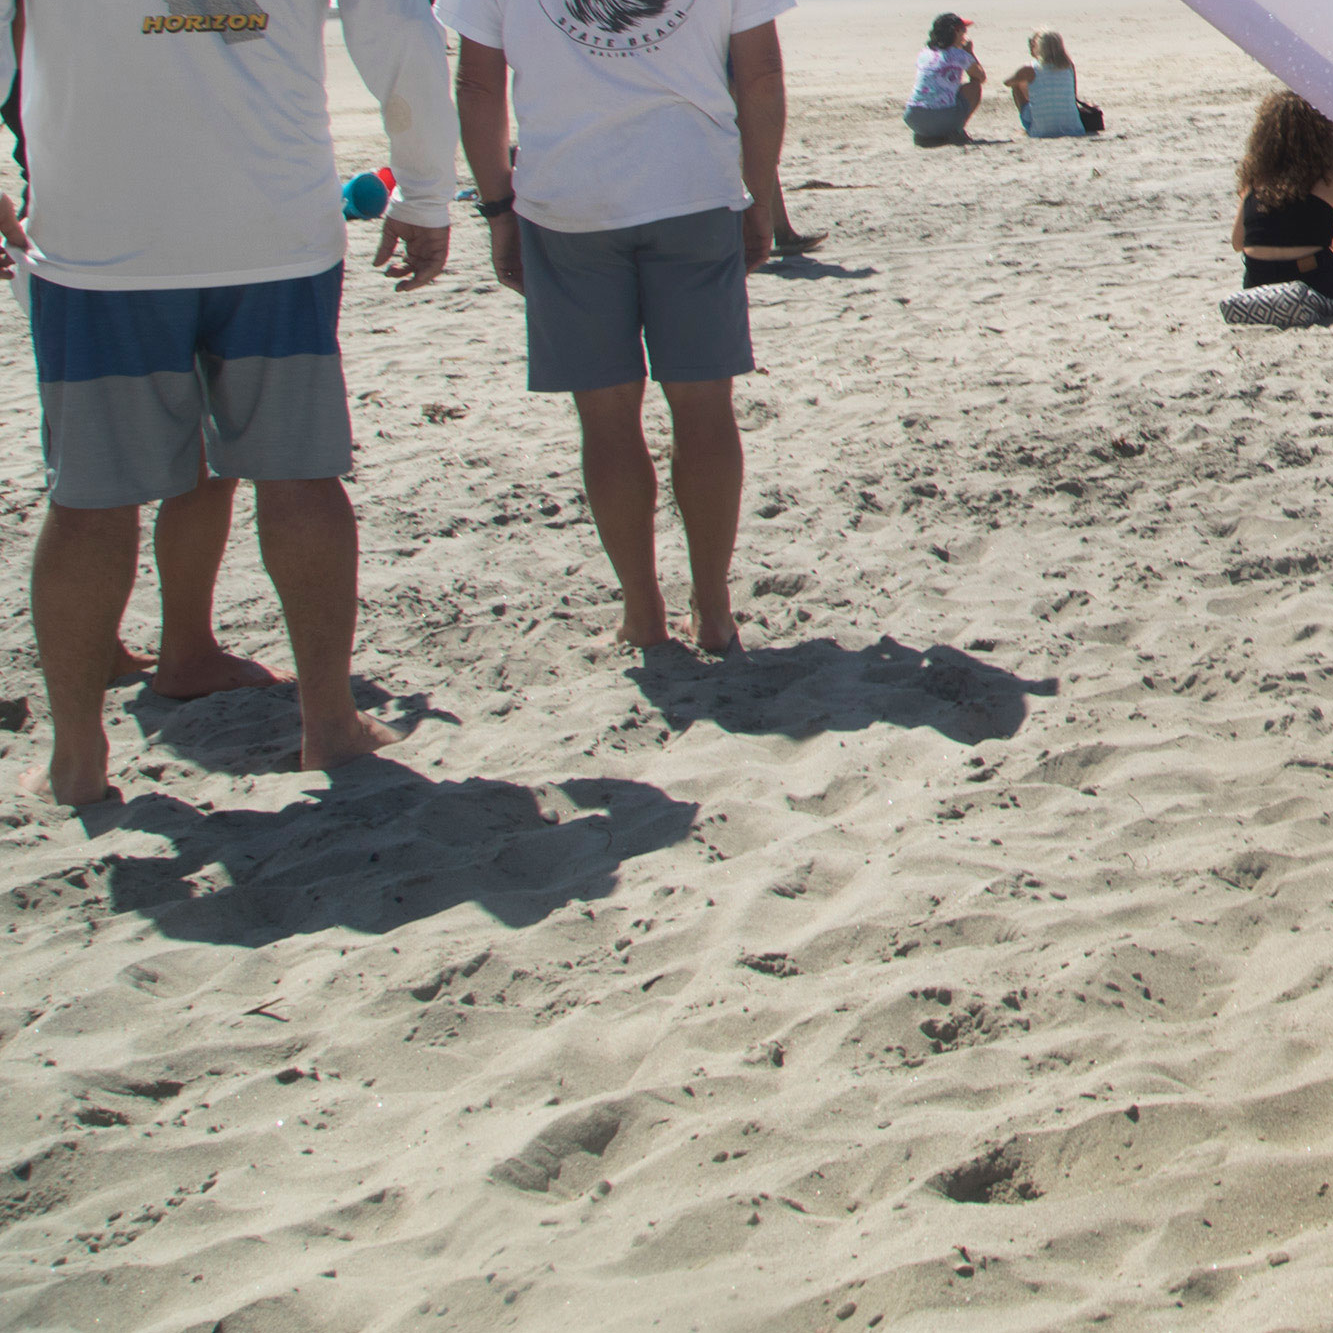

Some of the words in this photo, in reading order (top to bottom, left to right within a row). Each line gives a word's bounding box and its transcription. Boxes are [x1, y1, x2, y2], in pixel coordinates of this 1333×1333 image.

[142, 13, 269, 34] HORIZON
[558, 16, 615, 48] STATE
[628, 9, 687, 47] BEACH
